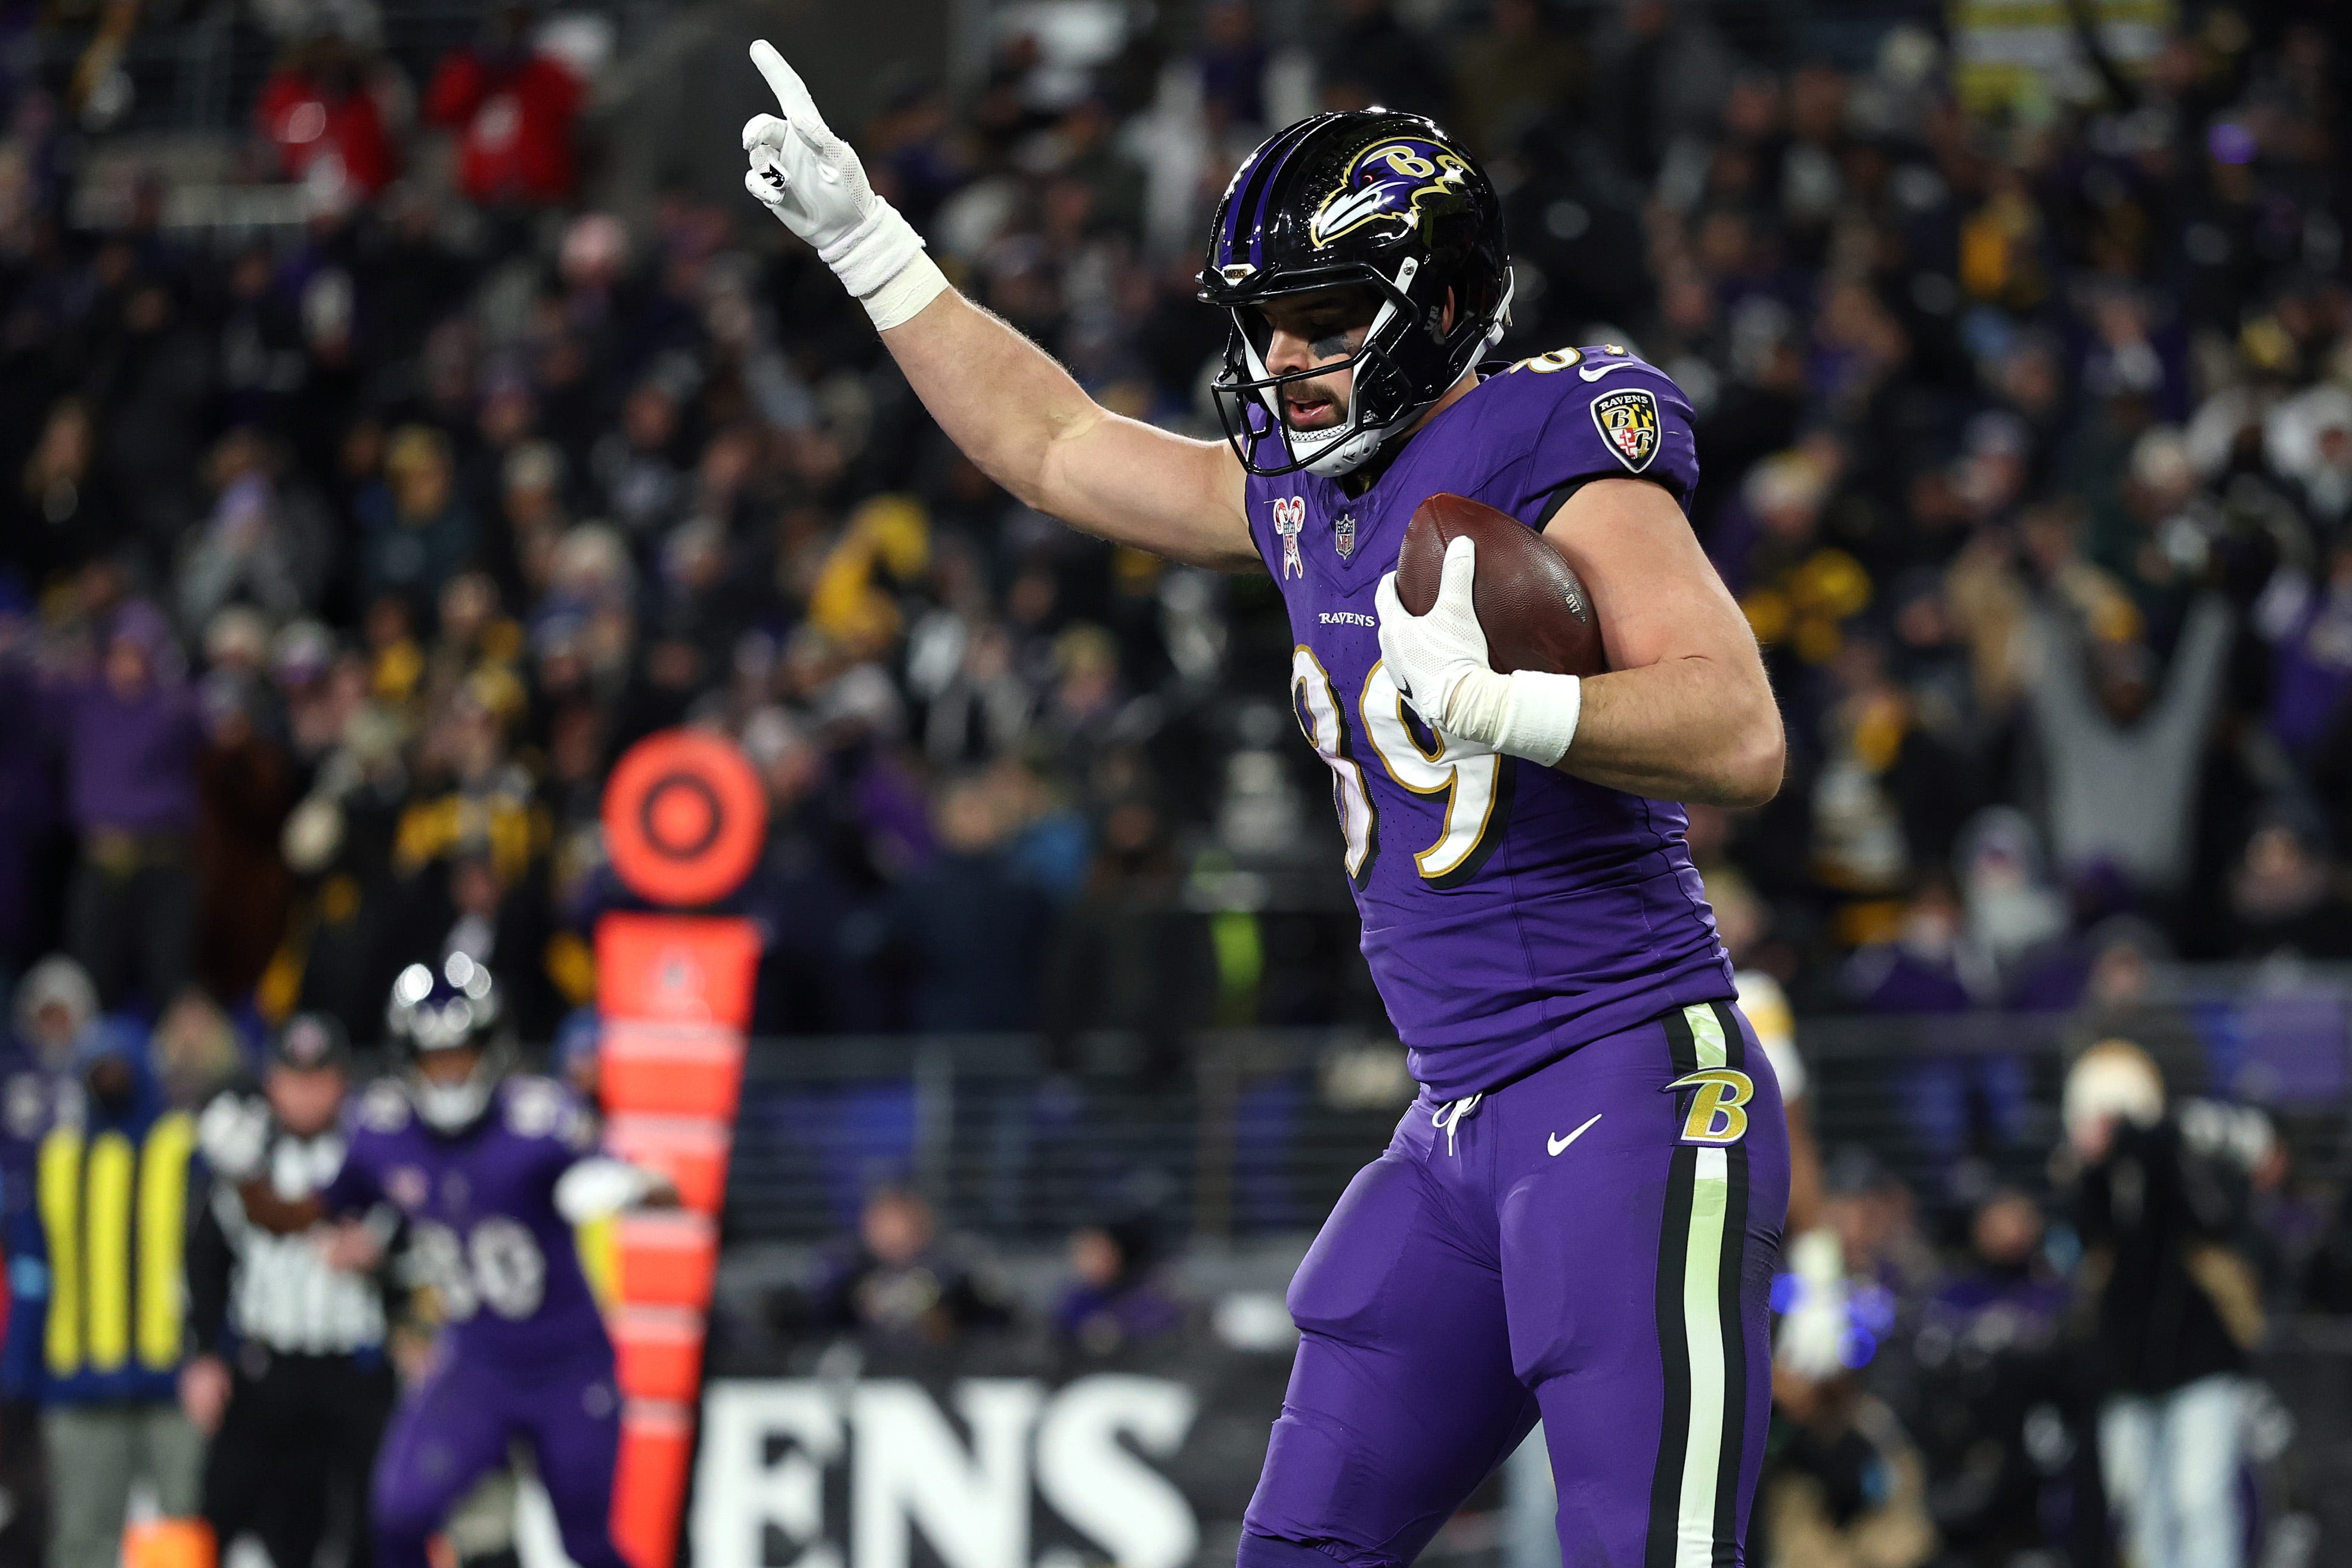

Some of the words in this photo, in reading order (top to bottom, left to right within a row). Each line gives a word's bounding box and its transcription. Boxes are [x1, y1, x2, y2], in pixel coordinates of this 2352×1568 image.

[1598, 395, 1649, 411] RAVENS
[1318, 611, 1375, 627] RAVENS
[1664, 1068, 1754, 1143] B
